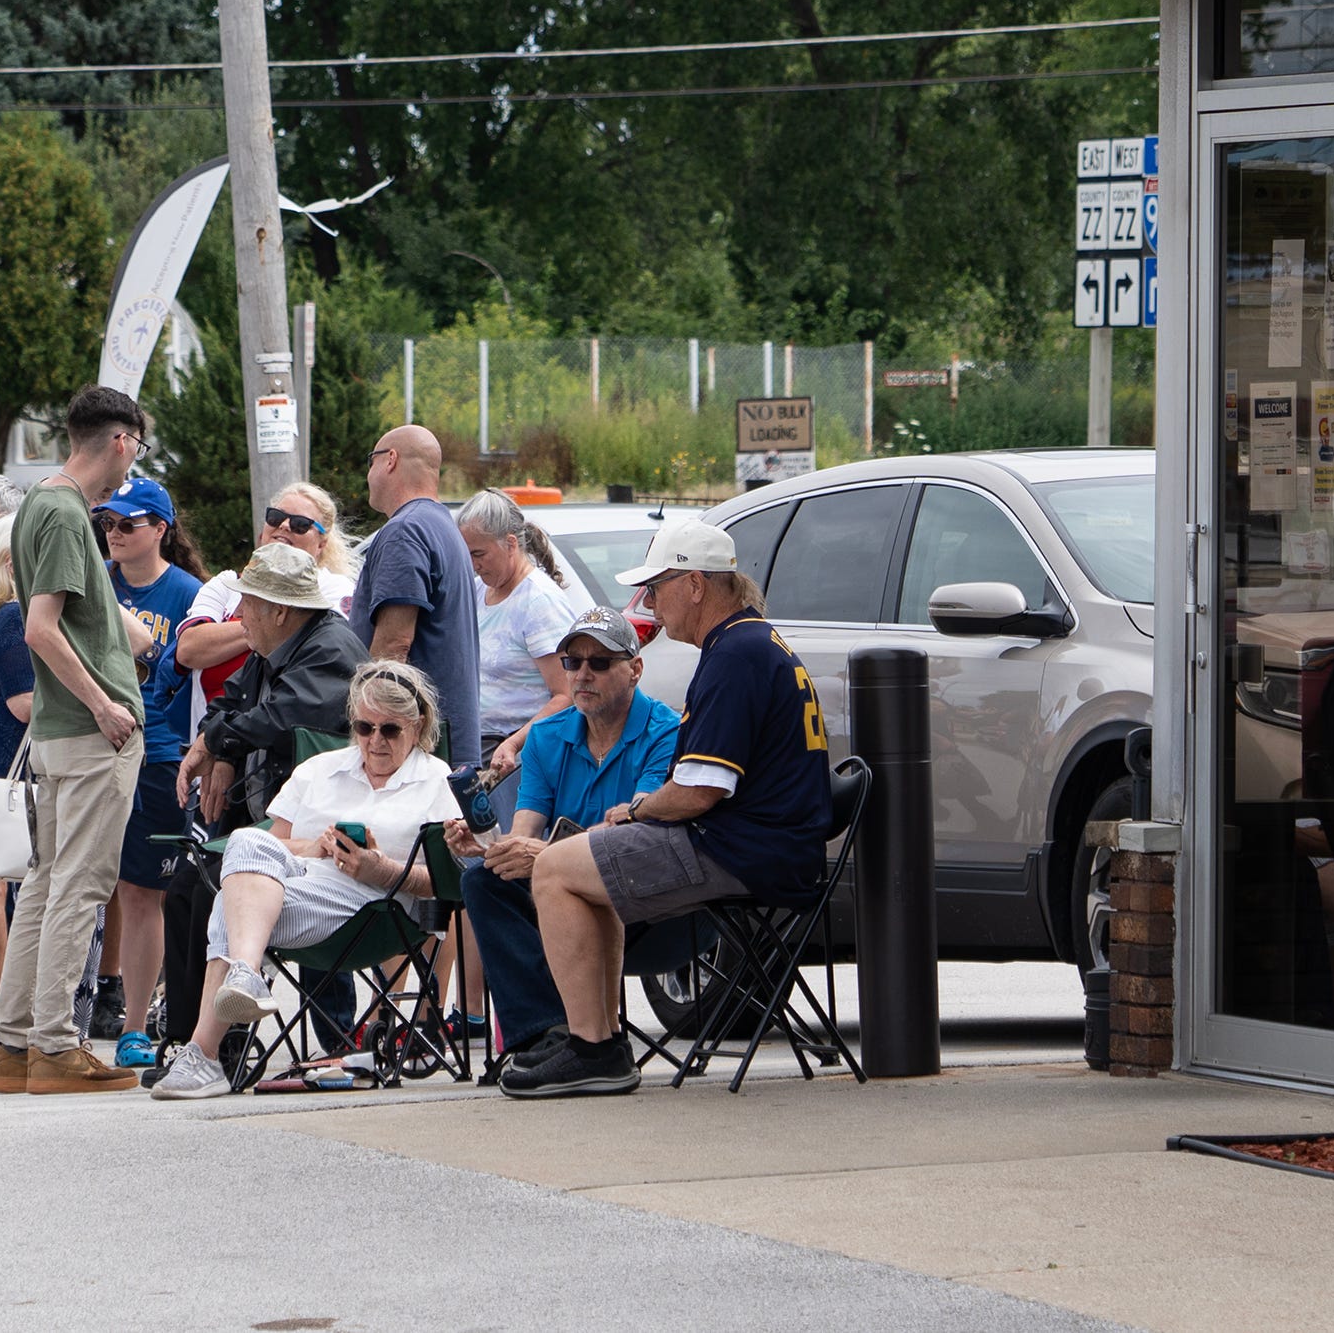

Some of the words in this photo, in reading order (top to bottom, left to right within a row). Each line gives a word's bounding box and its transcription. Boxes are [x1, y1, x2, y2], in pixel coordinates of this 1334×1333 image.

[1083, 147, 1105, 170] EAST
[1116, 146, 1139, 168] WEST
[1080, 190, 1105, 203] COUNTY
[1113, 189, 1139, 202] COUNTY
[1082, 207, 1102, 241] ZZ
[1114, 207, 1136, 241] ZZ
[1146, 197, 1158, 239] 9
[151, 245, 176, 295] Accepting
[180, 182, 204, 224] Patients
[111, 336, 139, 372] DENTAL
[742, 405, 773, 421] NO
[777, 405, 806, 420] BULK
[1258, 403, 1289, 415] WELCOME
[750, 426, 797, 442] LOADING
